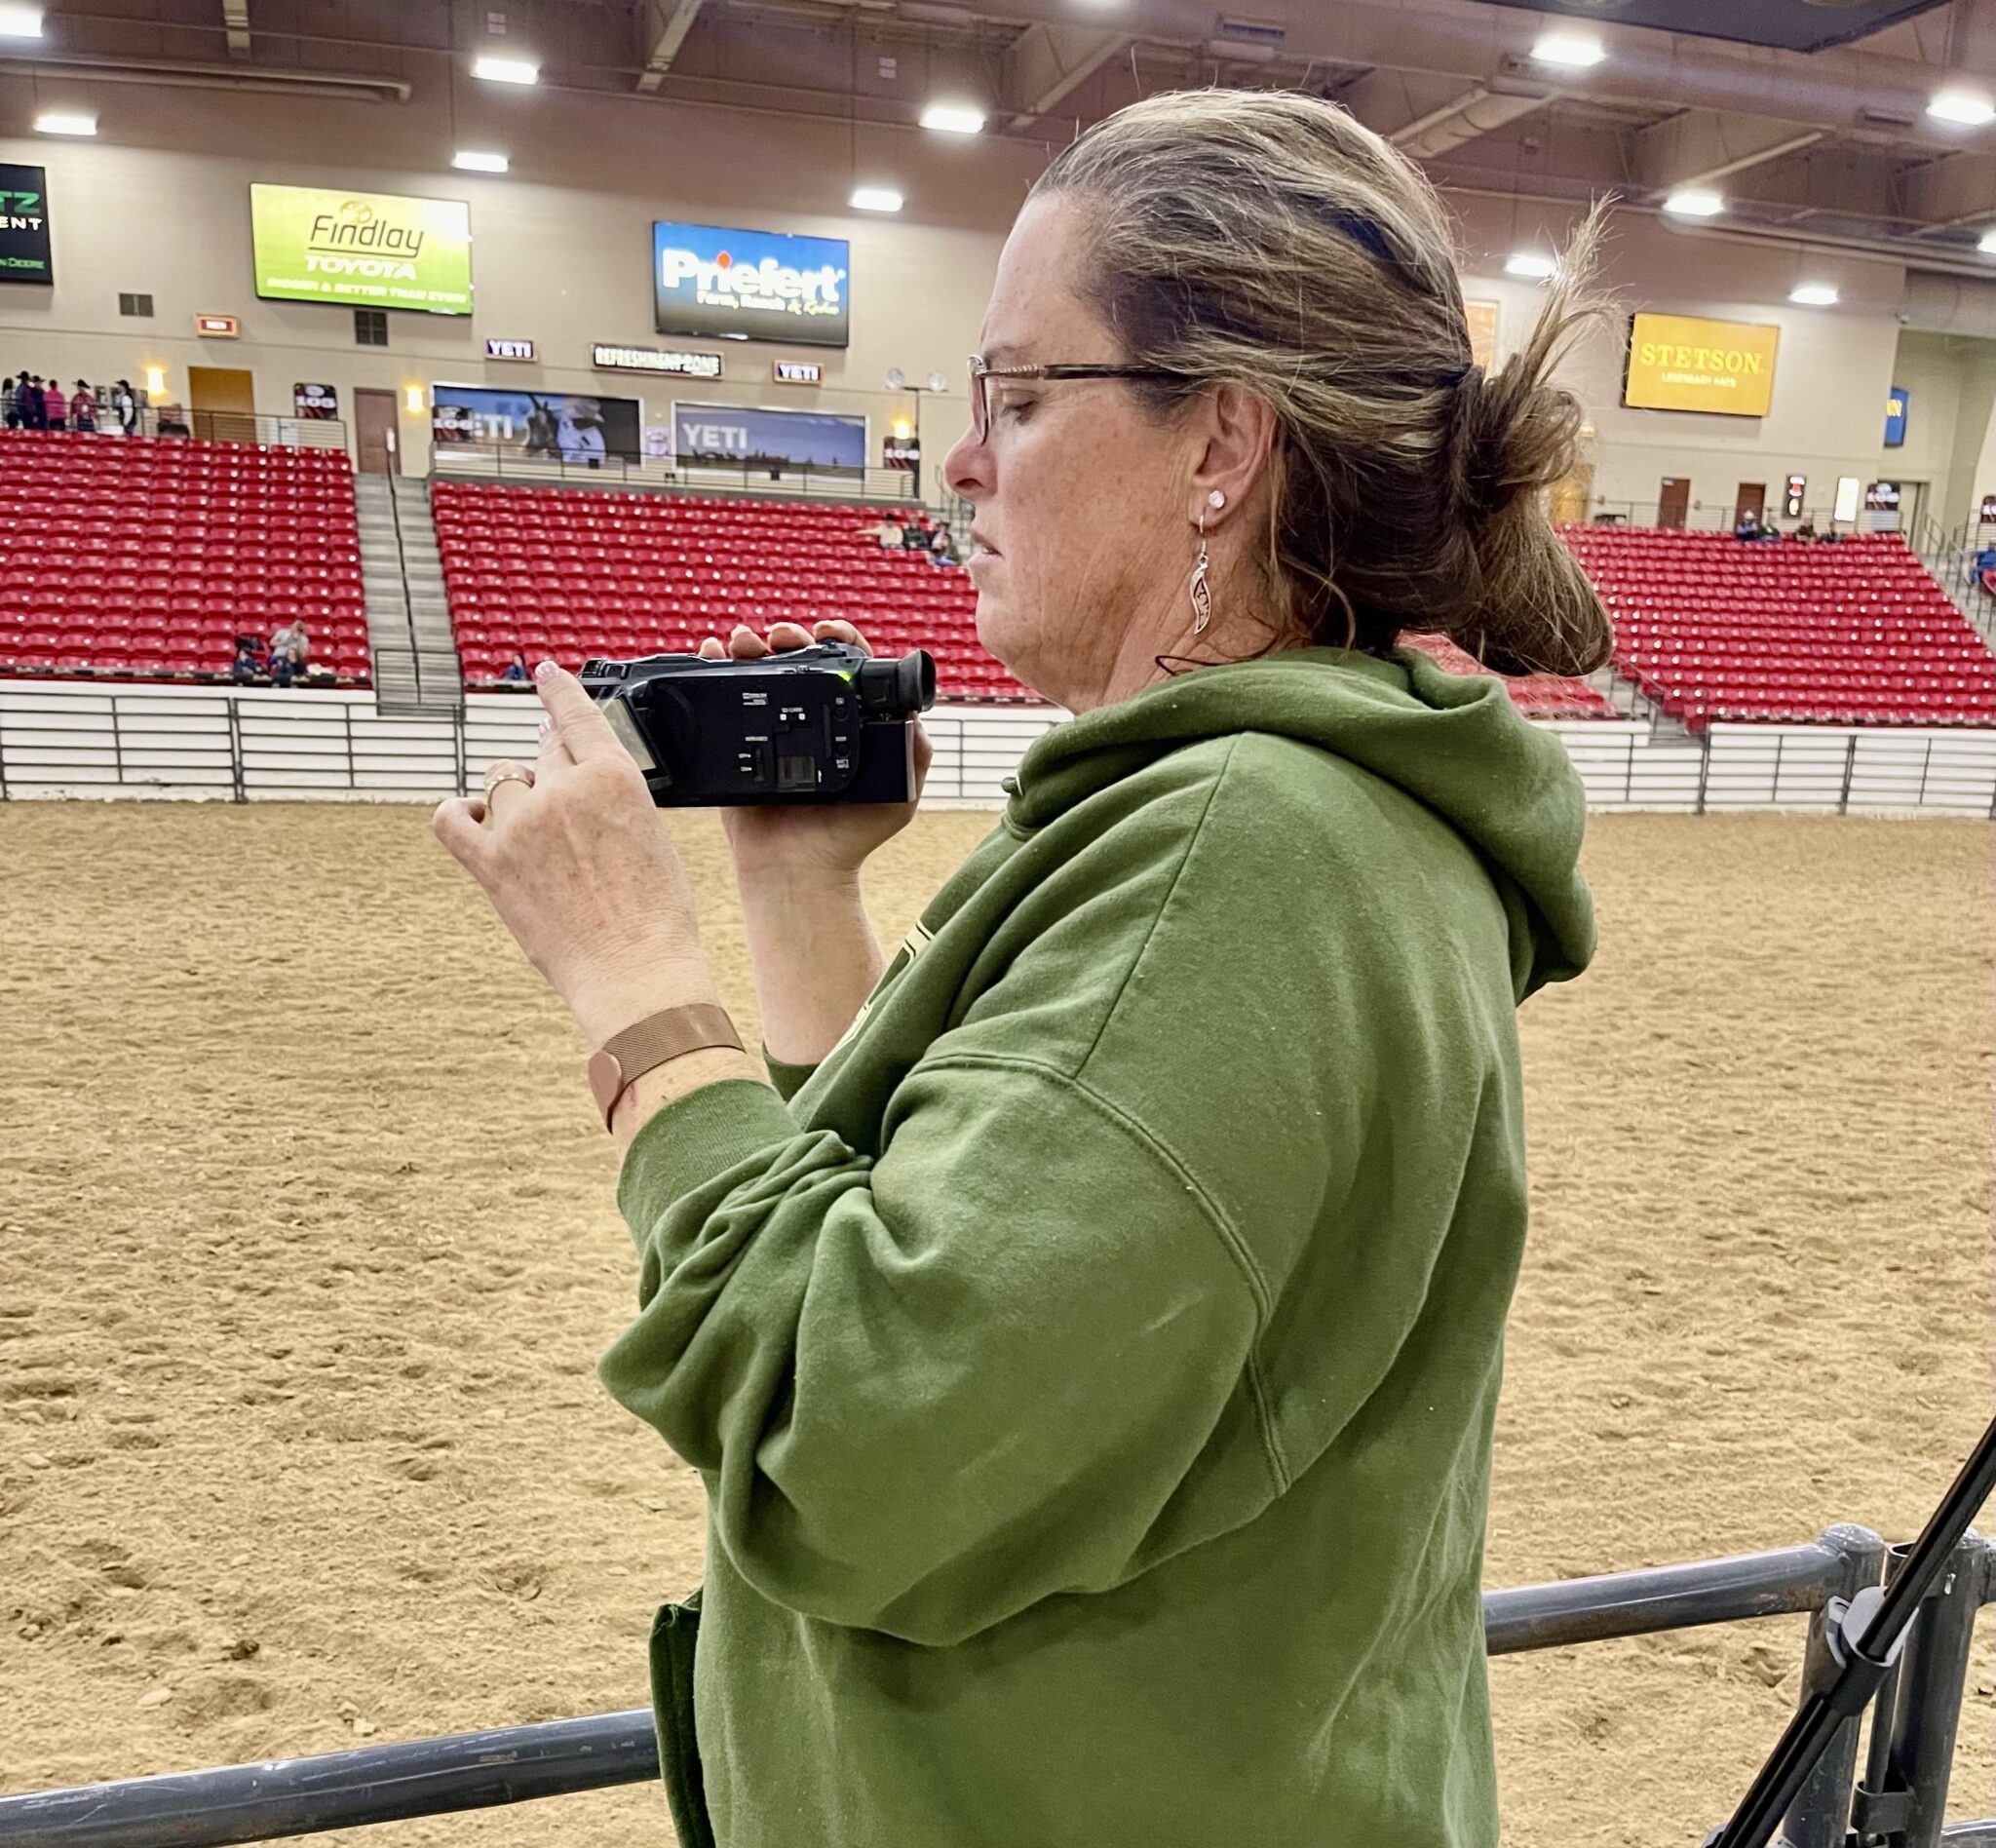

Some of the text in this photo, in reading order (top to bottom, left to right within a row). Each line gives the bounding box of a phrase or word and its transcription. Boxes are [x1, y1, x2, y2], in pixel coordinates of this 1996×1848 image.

[310, 213, 424, 258] Findlay
[305, 255, 417, 280] TOYOTA
[663, 249, 840, 302] Priefert
[487, 340, 531, 358] YETI
[1639, 342, 1762, 374] STETSON
[779, 365, 819, 381] YETI
[682, 423, 747, 449] YETI
